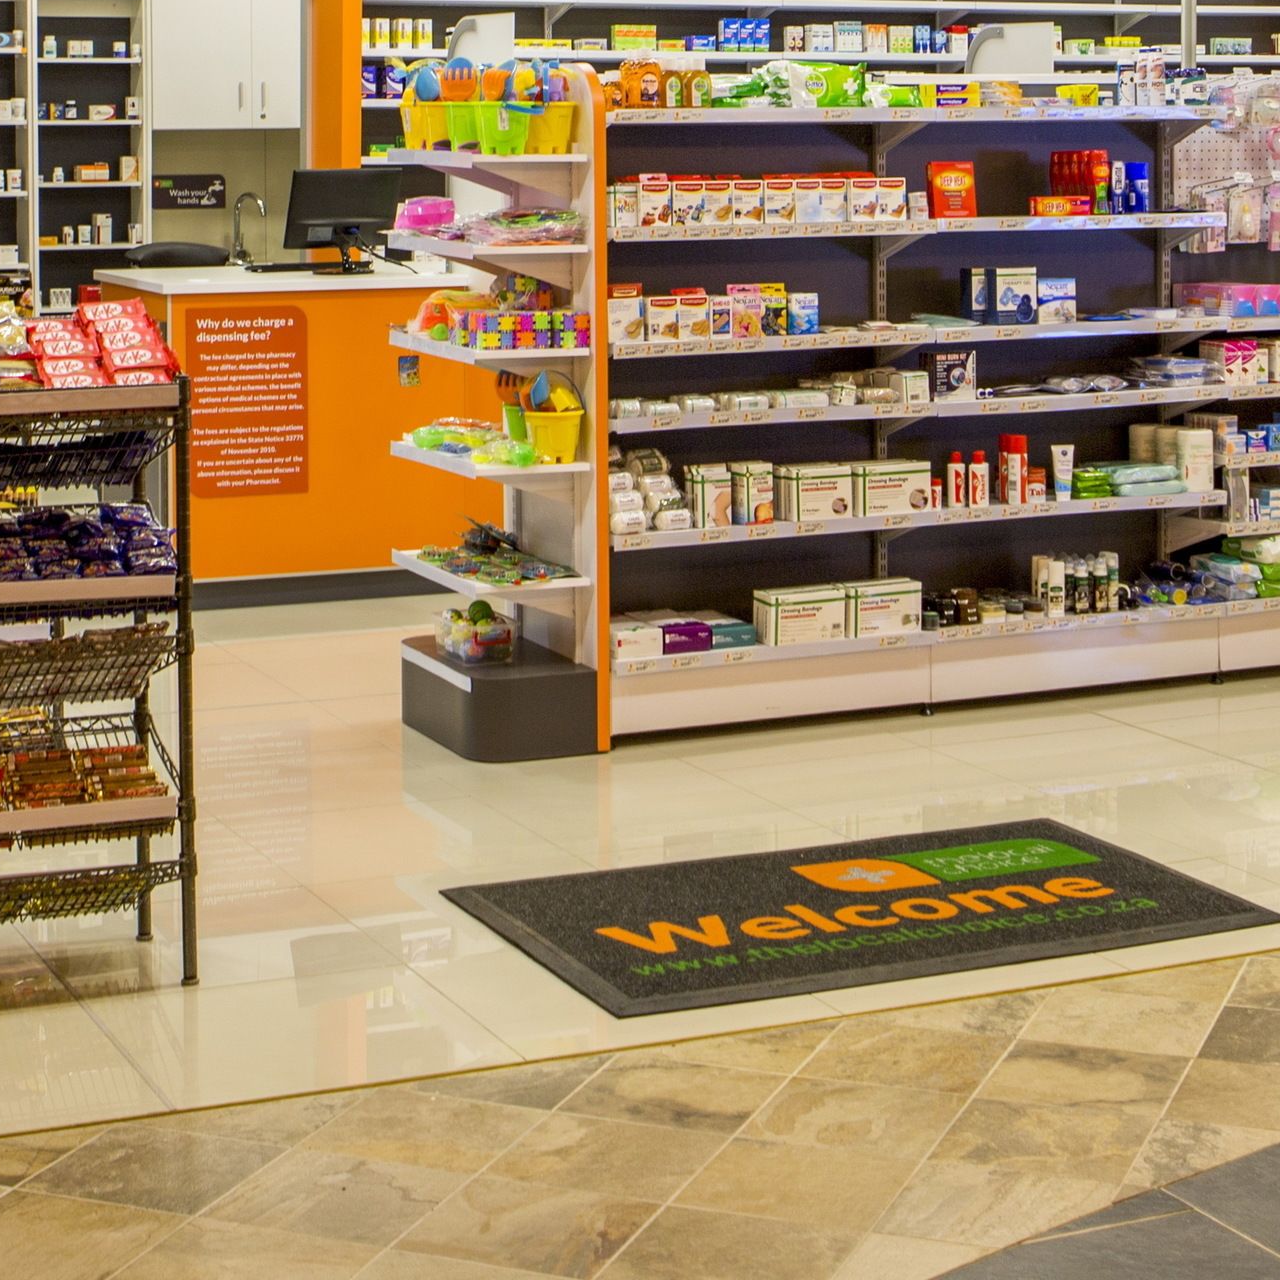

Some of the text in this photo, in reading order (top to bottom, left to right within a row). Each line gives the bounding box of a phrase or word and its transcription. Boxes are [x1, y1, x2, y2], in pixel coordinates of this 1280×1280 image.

[169, 189, 207, 198] Wash your
[177, 197, 199, 205] hands
[196, 317, 294, 331] Why do we charge a
[196, 330, 271, 344] dispensing fee?
[595, 874, 1116, 955] Welcome
